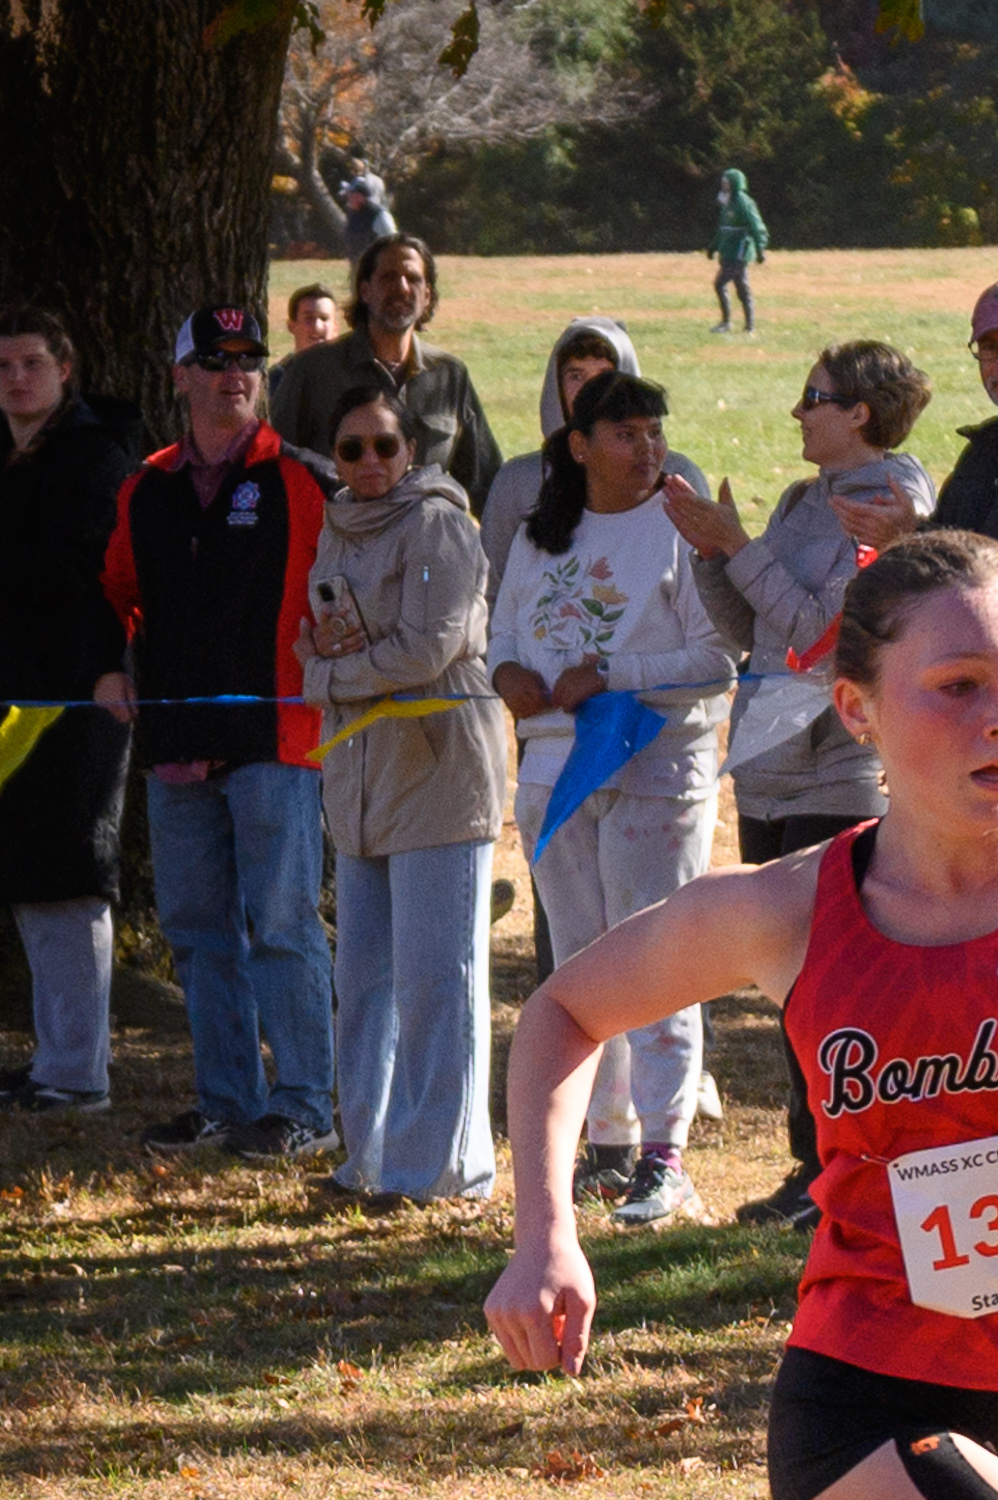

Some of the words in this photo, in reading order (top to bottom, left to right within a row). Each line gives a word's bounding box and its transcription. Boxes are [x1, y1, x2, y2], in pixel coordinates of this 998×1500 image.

[213, 309, 243, 331] W
[897, 1158, 959, 1181] WMASS
[962, 1154, 985, 1170] XC
